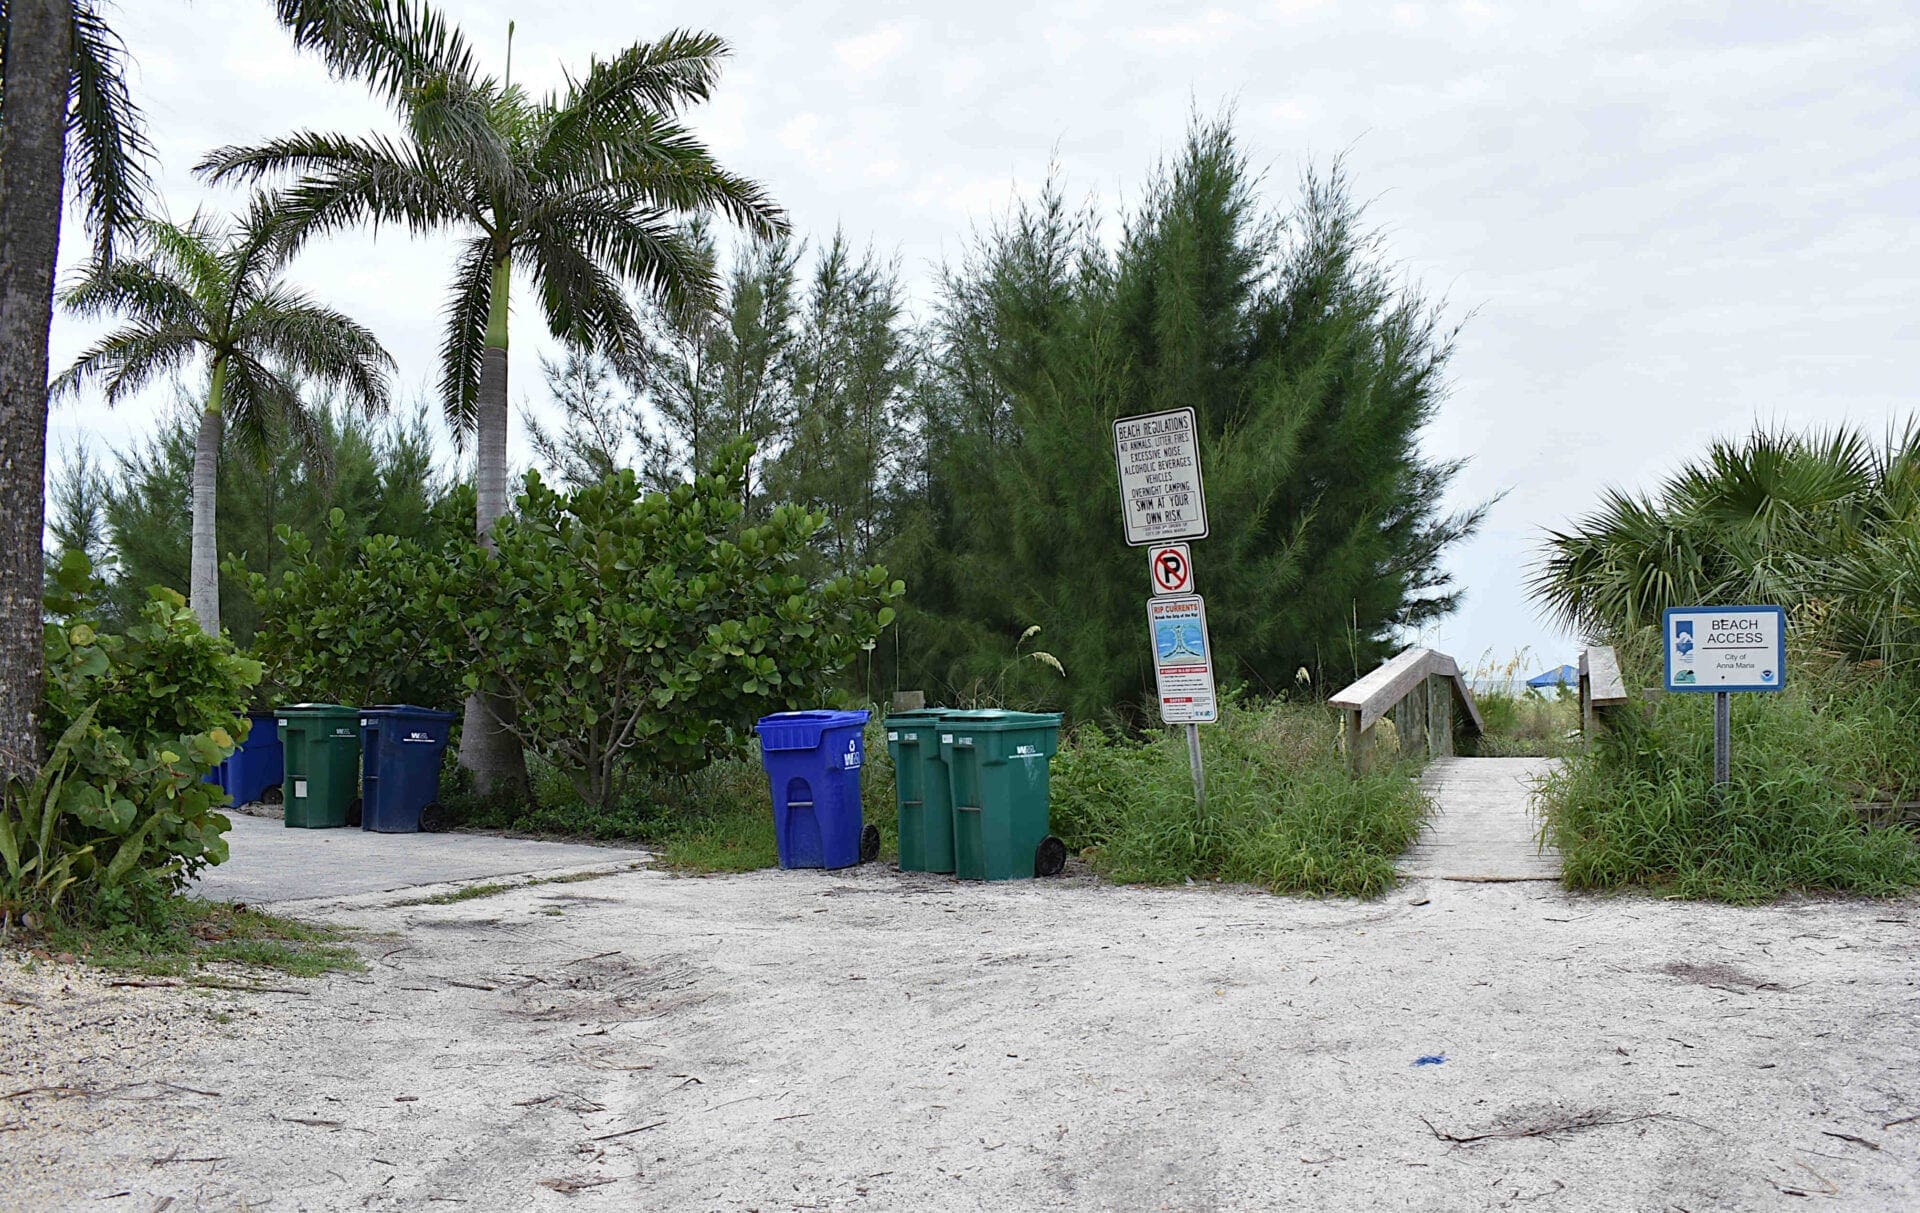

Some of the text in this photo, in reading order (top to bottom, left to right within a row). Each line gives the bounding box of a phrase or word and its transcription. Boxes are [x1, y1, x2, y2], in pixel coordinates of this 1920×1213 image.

[1118, 416, 1188, 440] BEACH REGULATIONS
[1120, 442, 1128, 452] NO
[1130, 449, 1161, 462] EXCESSIVE
[1124, 460, 1156, 476] ALCOHOLIC
[1132, 481, 1190, 498] OVERNIGHT CAMPING
[1136, 494, 1189, 512] SWIM AT YOUR
[1146, 510, 1182, 524] OWN RISK
[1166, 603, 1198, 613] CURRENTS
[1712, 619, 1758, 630] BEACH
[1707, 633, 1763, 644] ACCESS
